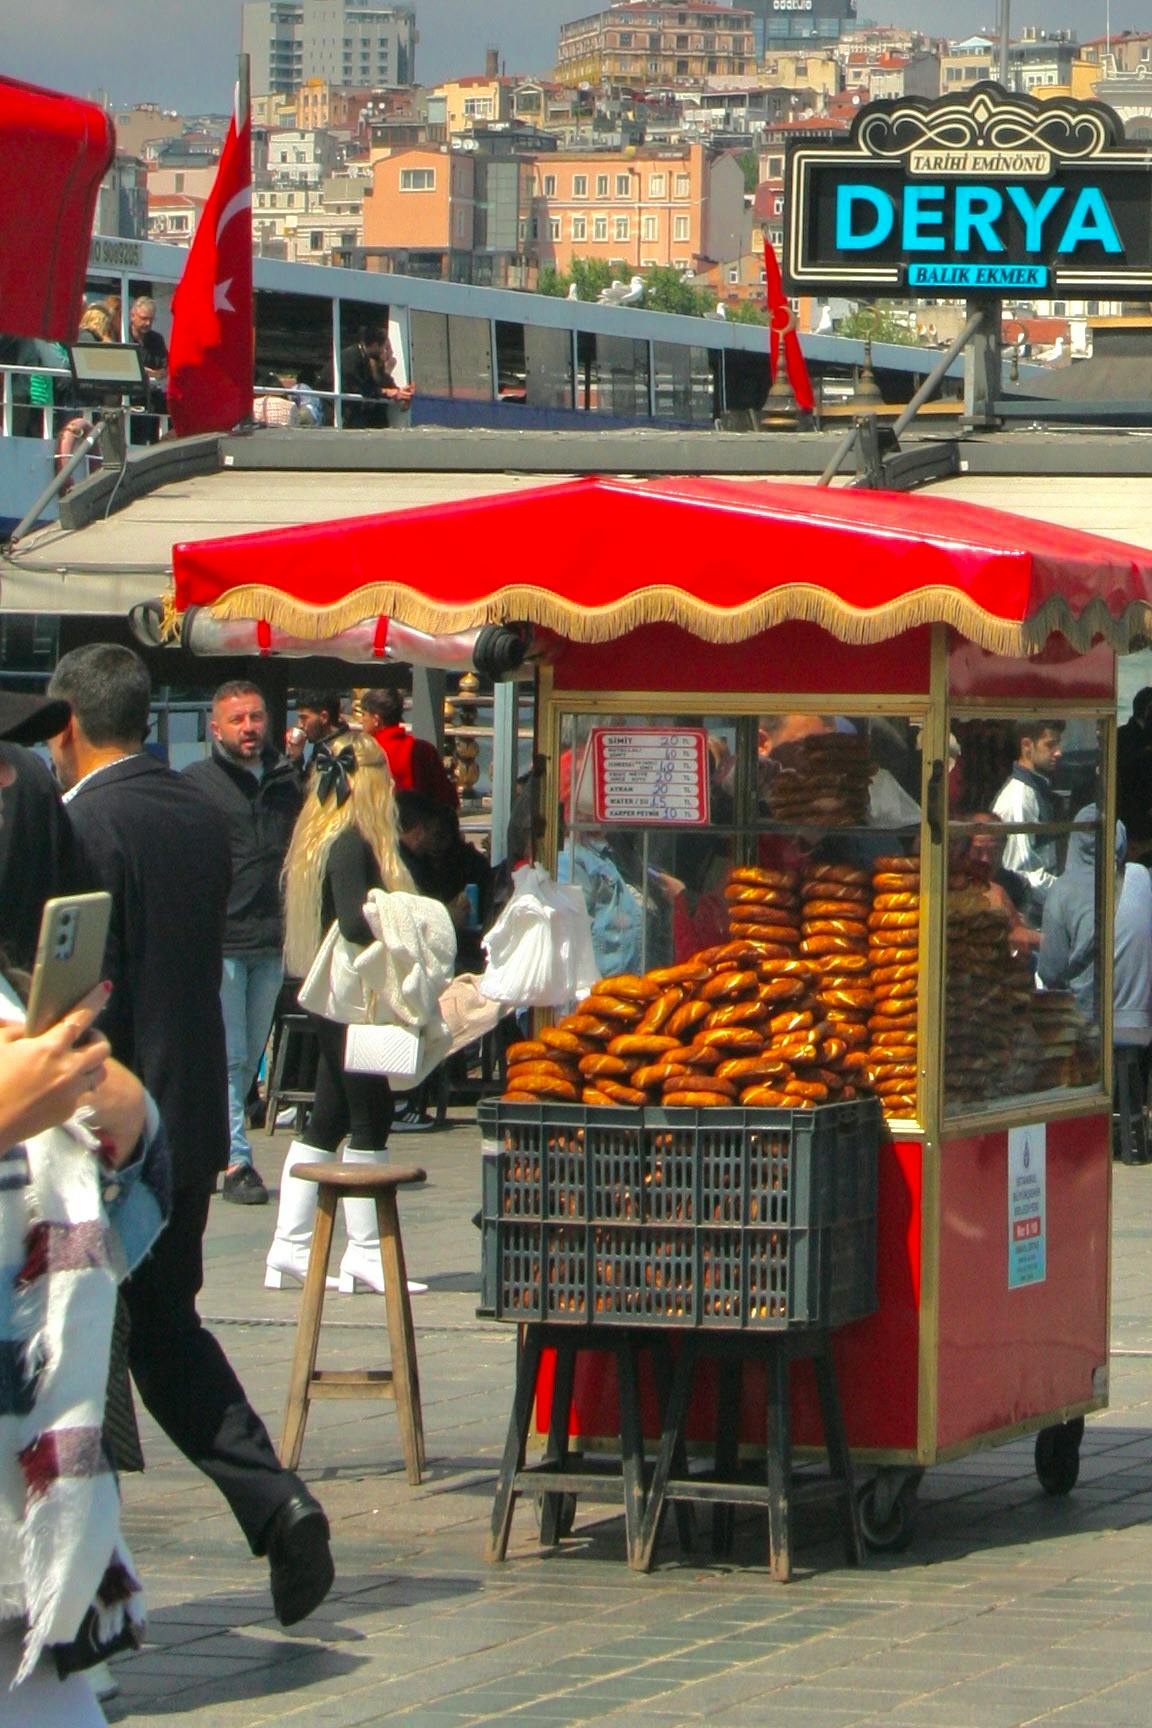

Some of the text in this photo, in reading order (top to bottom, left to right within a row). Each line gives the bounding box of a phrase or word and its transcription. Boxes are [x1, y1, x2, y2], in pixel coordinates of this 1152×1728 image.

[913, 151, 1047, 172] TARİHİ EMİNÖNÜ
[835, 184, 1123, 254] DERYA
[915, 268, 1040, 285] BALIK EKMEK
